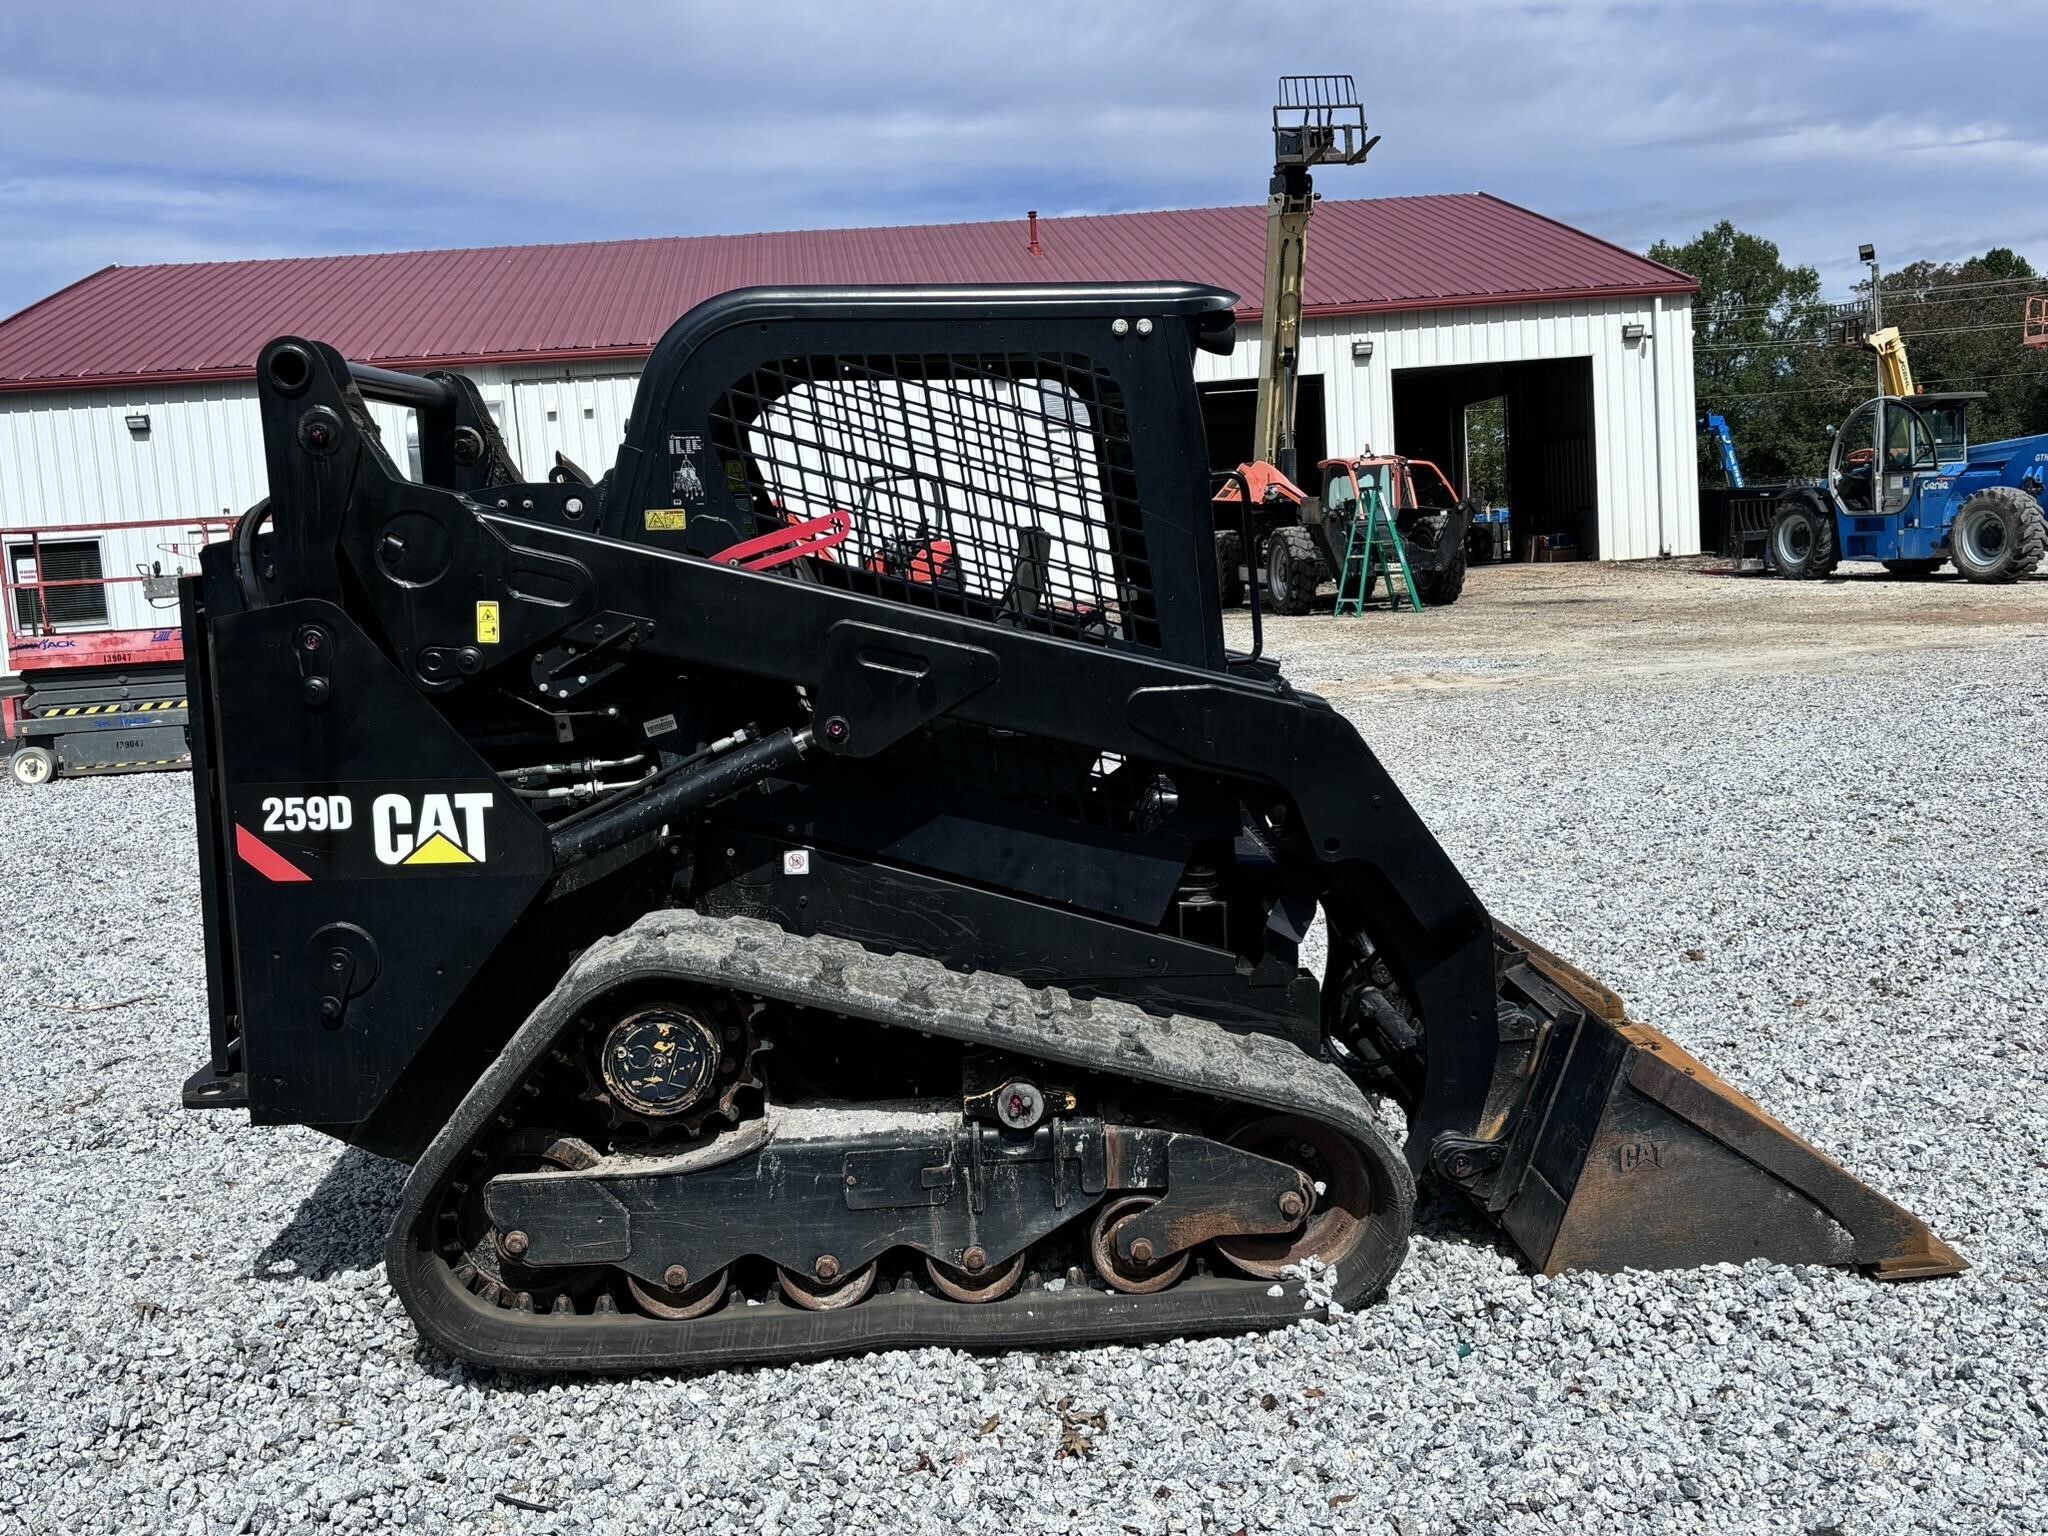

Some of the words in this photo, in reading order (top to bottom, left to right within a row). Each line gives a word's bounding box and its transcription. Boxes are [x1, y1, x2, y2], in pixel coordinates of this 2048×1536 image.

[1922, 479, 1950, 490] Genie
[103, 653, 132, 663] 139047
[116, 740, 144, 750] 139047
[262, 795, 353, 832] 259D
[372, 792, 494, 865] CAT
[1619, 1140, 1668, 1173] CAT
